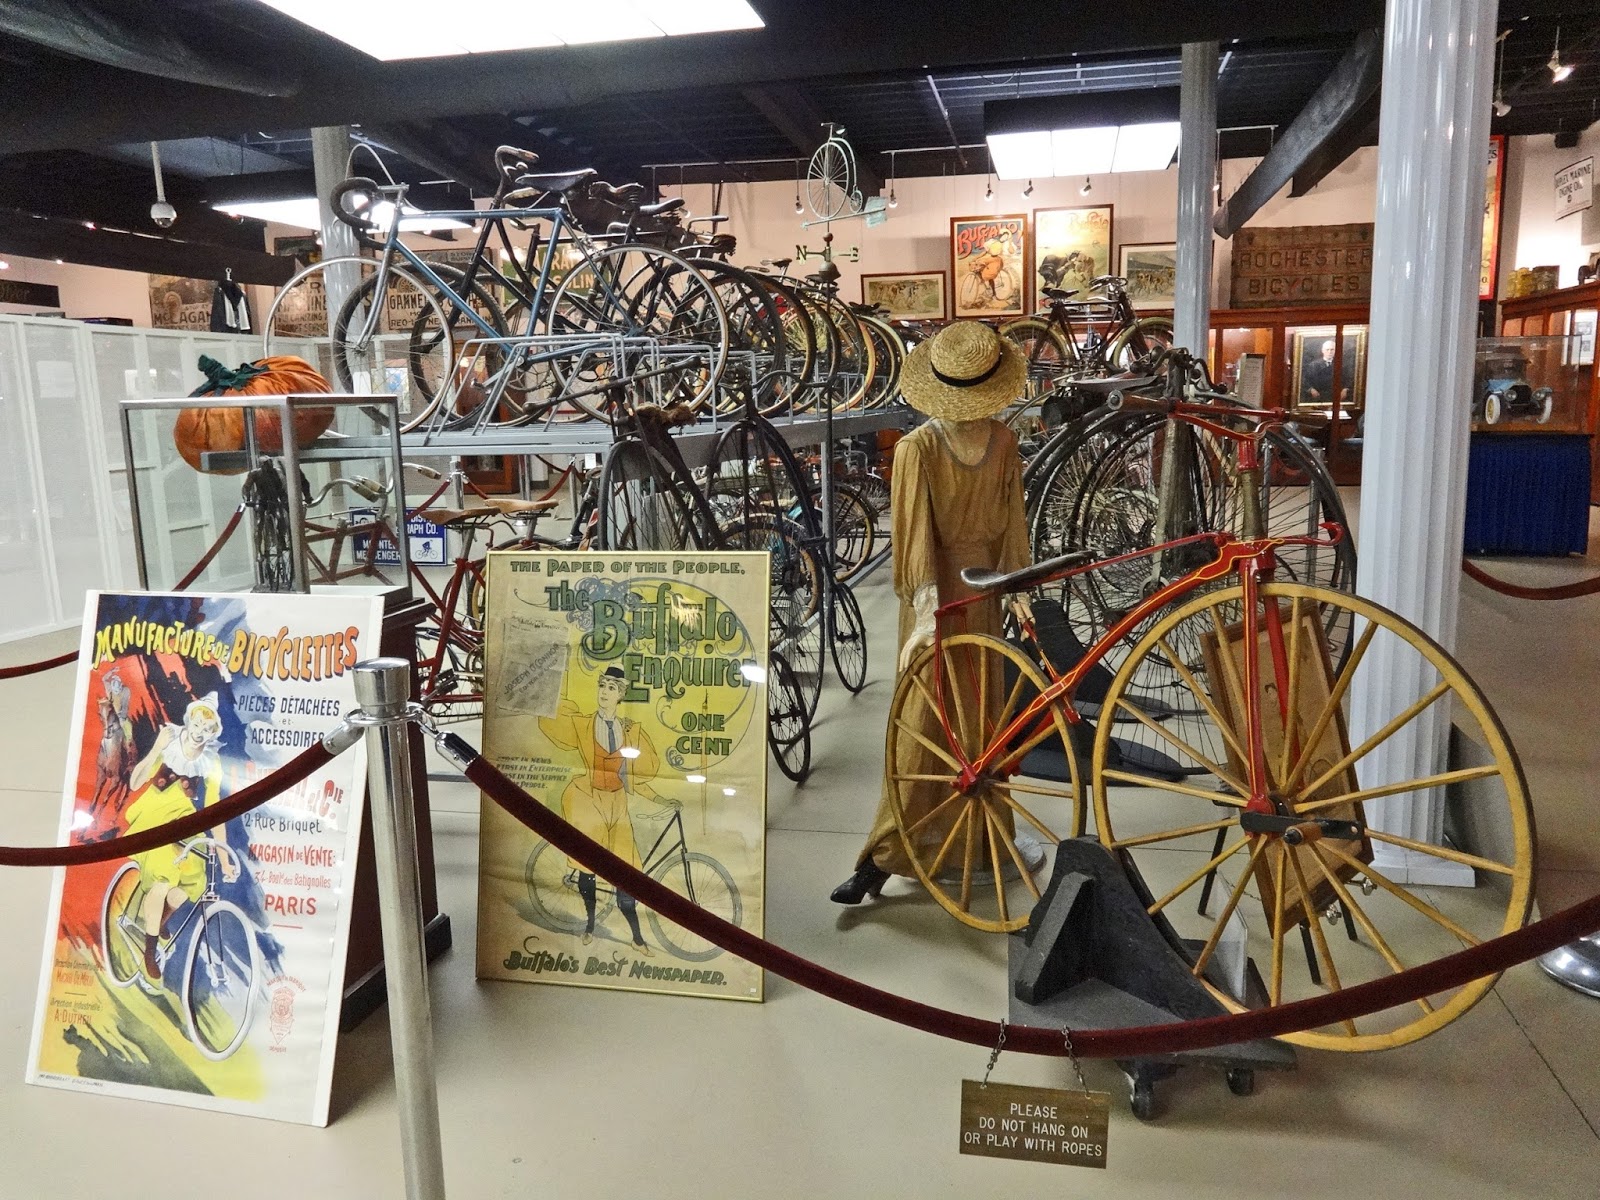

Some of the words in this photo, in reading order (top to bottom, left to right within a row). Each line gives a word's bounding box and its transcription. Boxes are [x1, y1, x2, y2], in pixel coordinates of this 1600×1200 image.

[1240, 248, 1373, 269] ROCHESTER
[1249, 275, 1360, 296] BICYCLES
[511, 560, 541, 573] THE
[547, 559, 605, 577] PAPER
[611, 561, 632, 573] OF
[635, 561, 667, 573] THE
[672, 560, 746, 575] PEOPLE.
[545, 580, 590, 611] The
[581, 582, 740, 660] Buffalo
[93, 615, 214, 671] MANUFACTURE
[213, 641, 229, 662] DE
[227, 626, 360, 682] BICYCLETTES
[681, 711, 725, 732] ONE
[676, 735, 733, 756] CENT
[254, 812, 277, 832] Rue
[279, 818, 323, 836] Briquet
[248, 843, 295, 865] MAGASIN
[264, 893, 318, 917] PARIS
[503, 936, 580, 974] Buffalo's
[584, 950, 629, 977] Best
[1010, 1103, 1058, 1119] PLEASE
[979, 1117, 996, 1129] DO
[1001, 1119, 1026, 1132] NOT
[1032, 1122, 1066, 1137] HANG
[1071, 1125, 1089, 1138] ON
[964, 1132, 981, 1144] OR
[986, 1134, 1018, 1148] PLAY
[1024, 1137, 1056, 1152] WITH
[1062, 1141, 1103, 1157] ROPES
